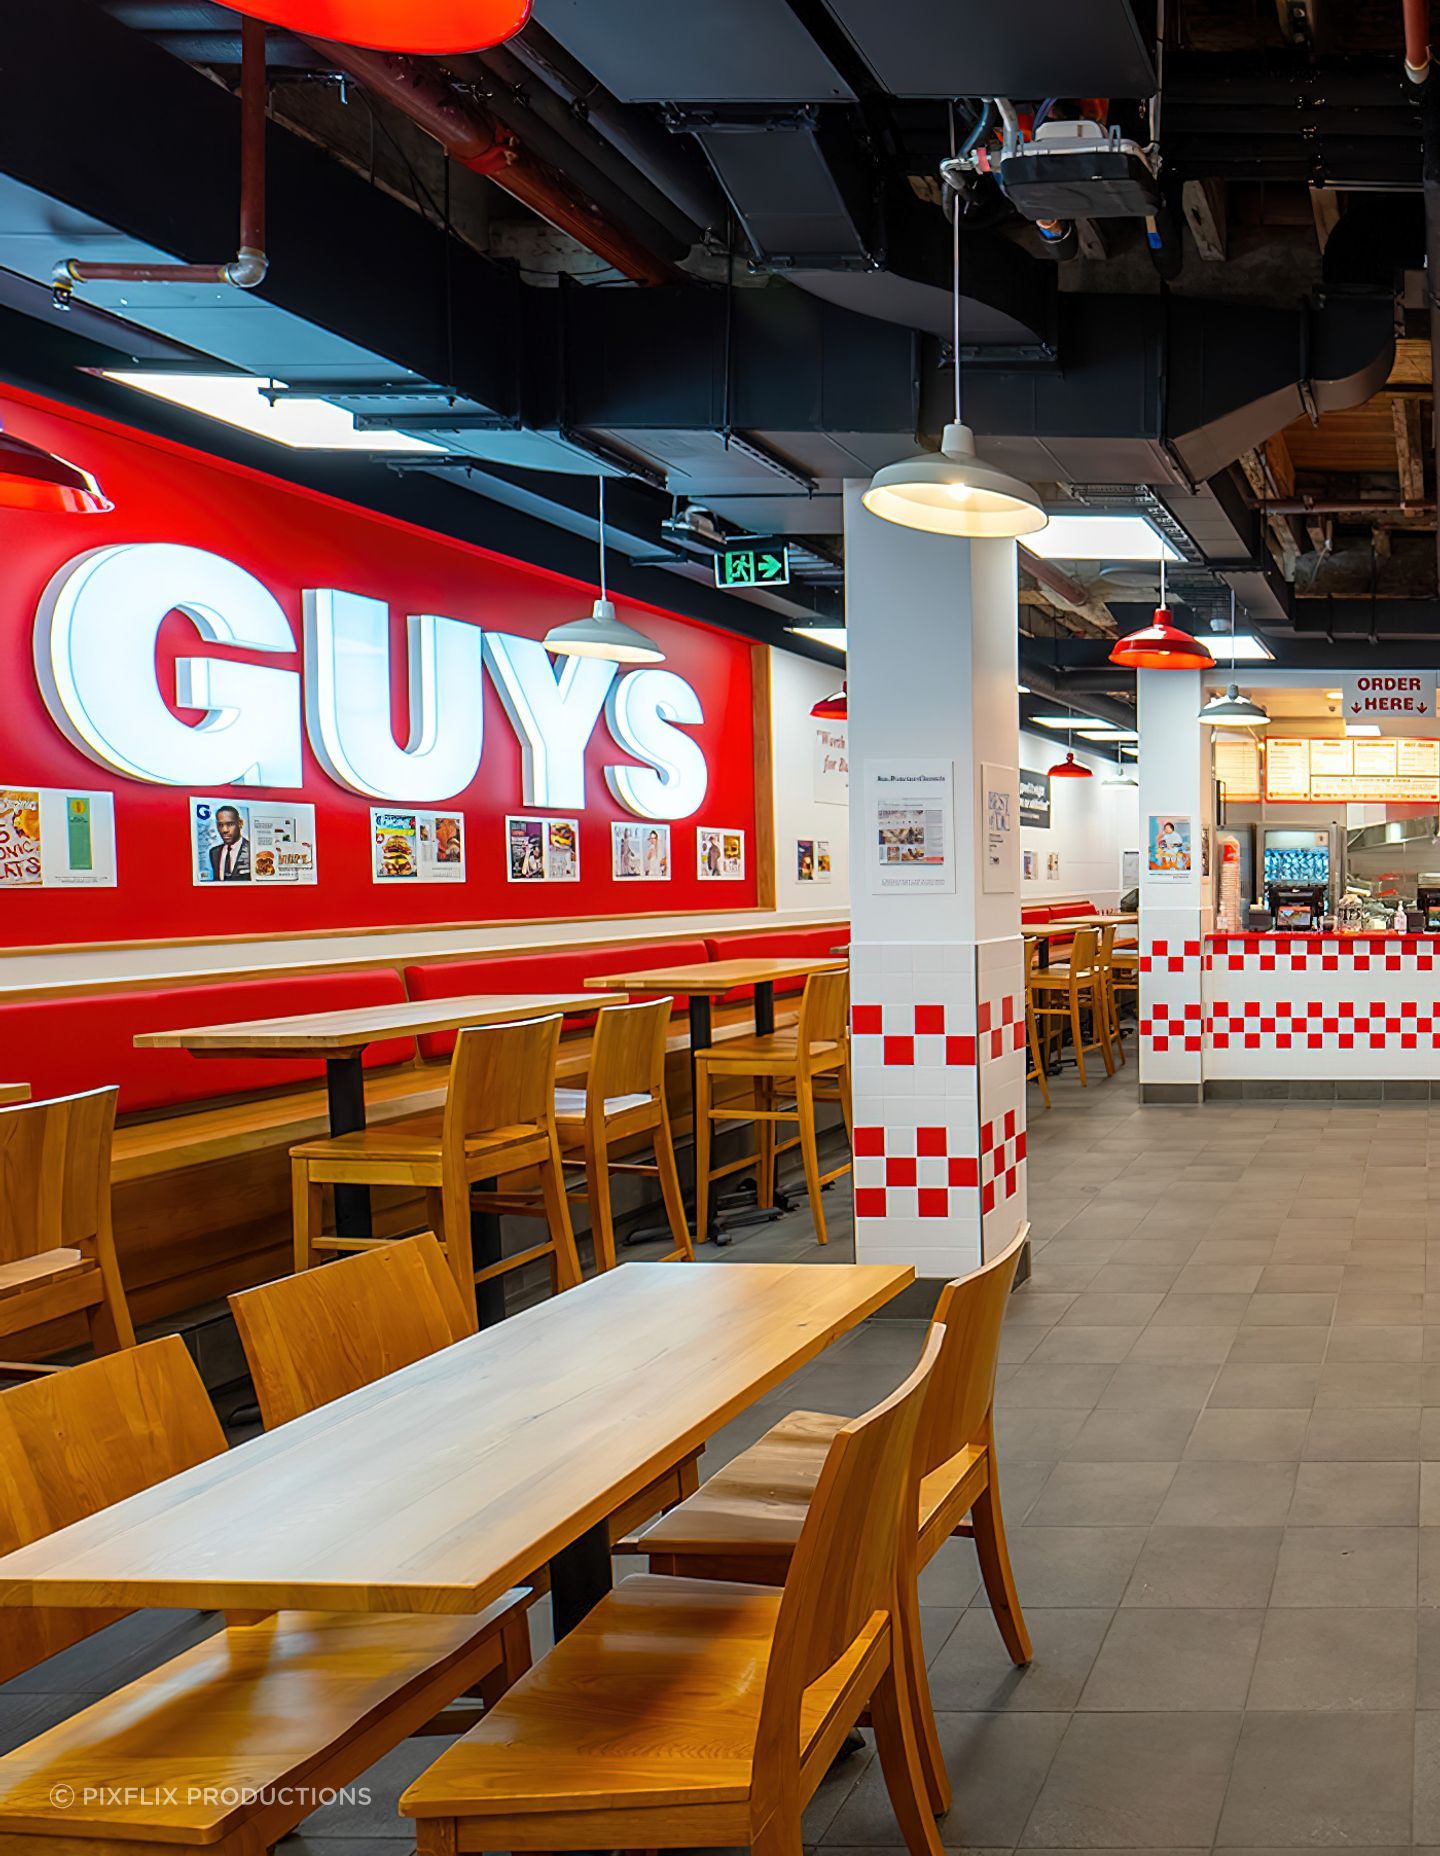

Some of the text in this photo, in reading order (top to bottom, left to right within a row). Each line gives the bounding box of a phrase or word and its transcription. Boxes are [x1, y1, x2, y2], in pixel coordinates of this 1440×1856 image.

[33, 542, 707, 818] GUYS
[1357, 677, 1421, 691] ORDER
[1364, 697, 1414, 711] HERE
